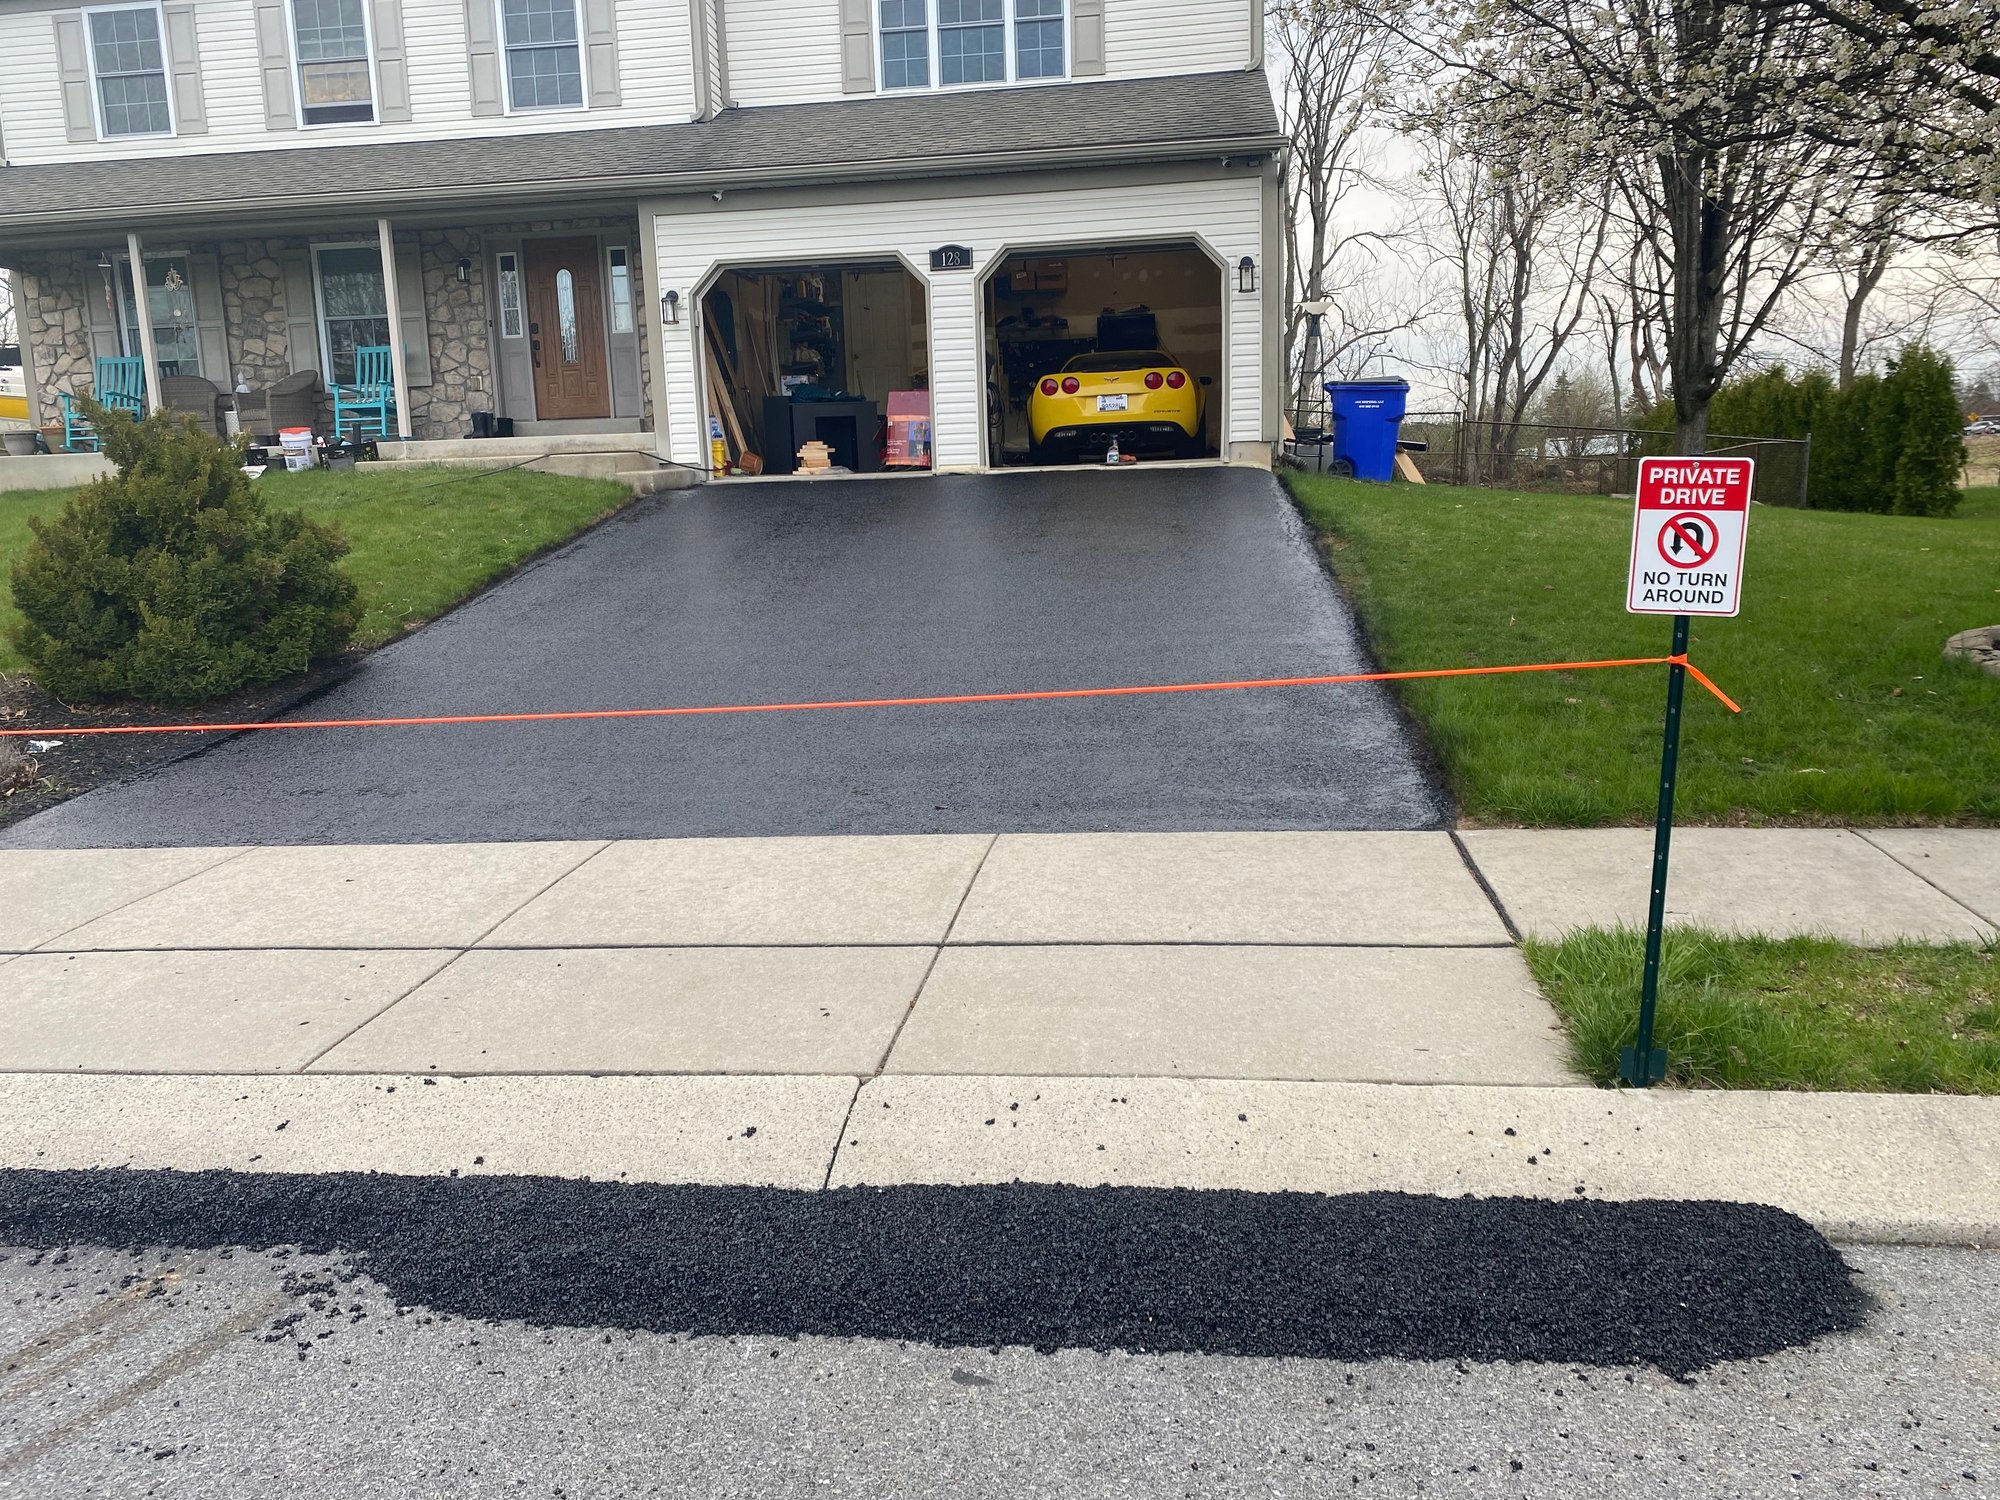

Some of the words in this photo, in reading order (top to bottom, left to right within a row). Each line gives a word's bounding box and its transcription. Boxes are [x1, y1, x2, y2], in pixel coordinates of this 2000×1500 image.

[942, 251, 961, 267] 128
[1649, 467, 1741, 485] PRIVATE
[1660, 488, 1727, 505] DRIVE
[1643, 571, 1671, 586] NO
[1677, 572, 1728, 587] TURN
[1642, 589, 1724, 604] AROUND
